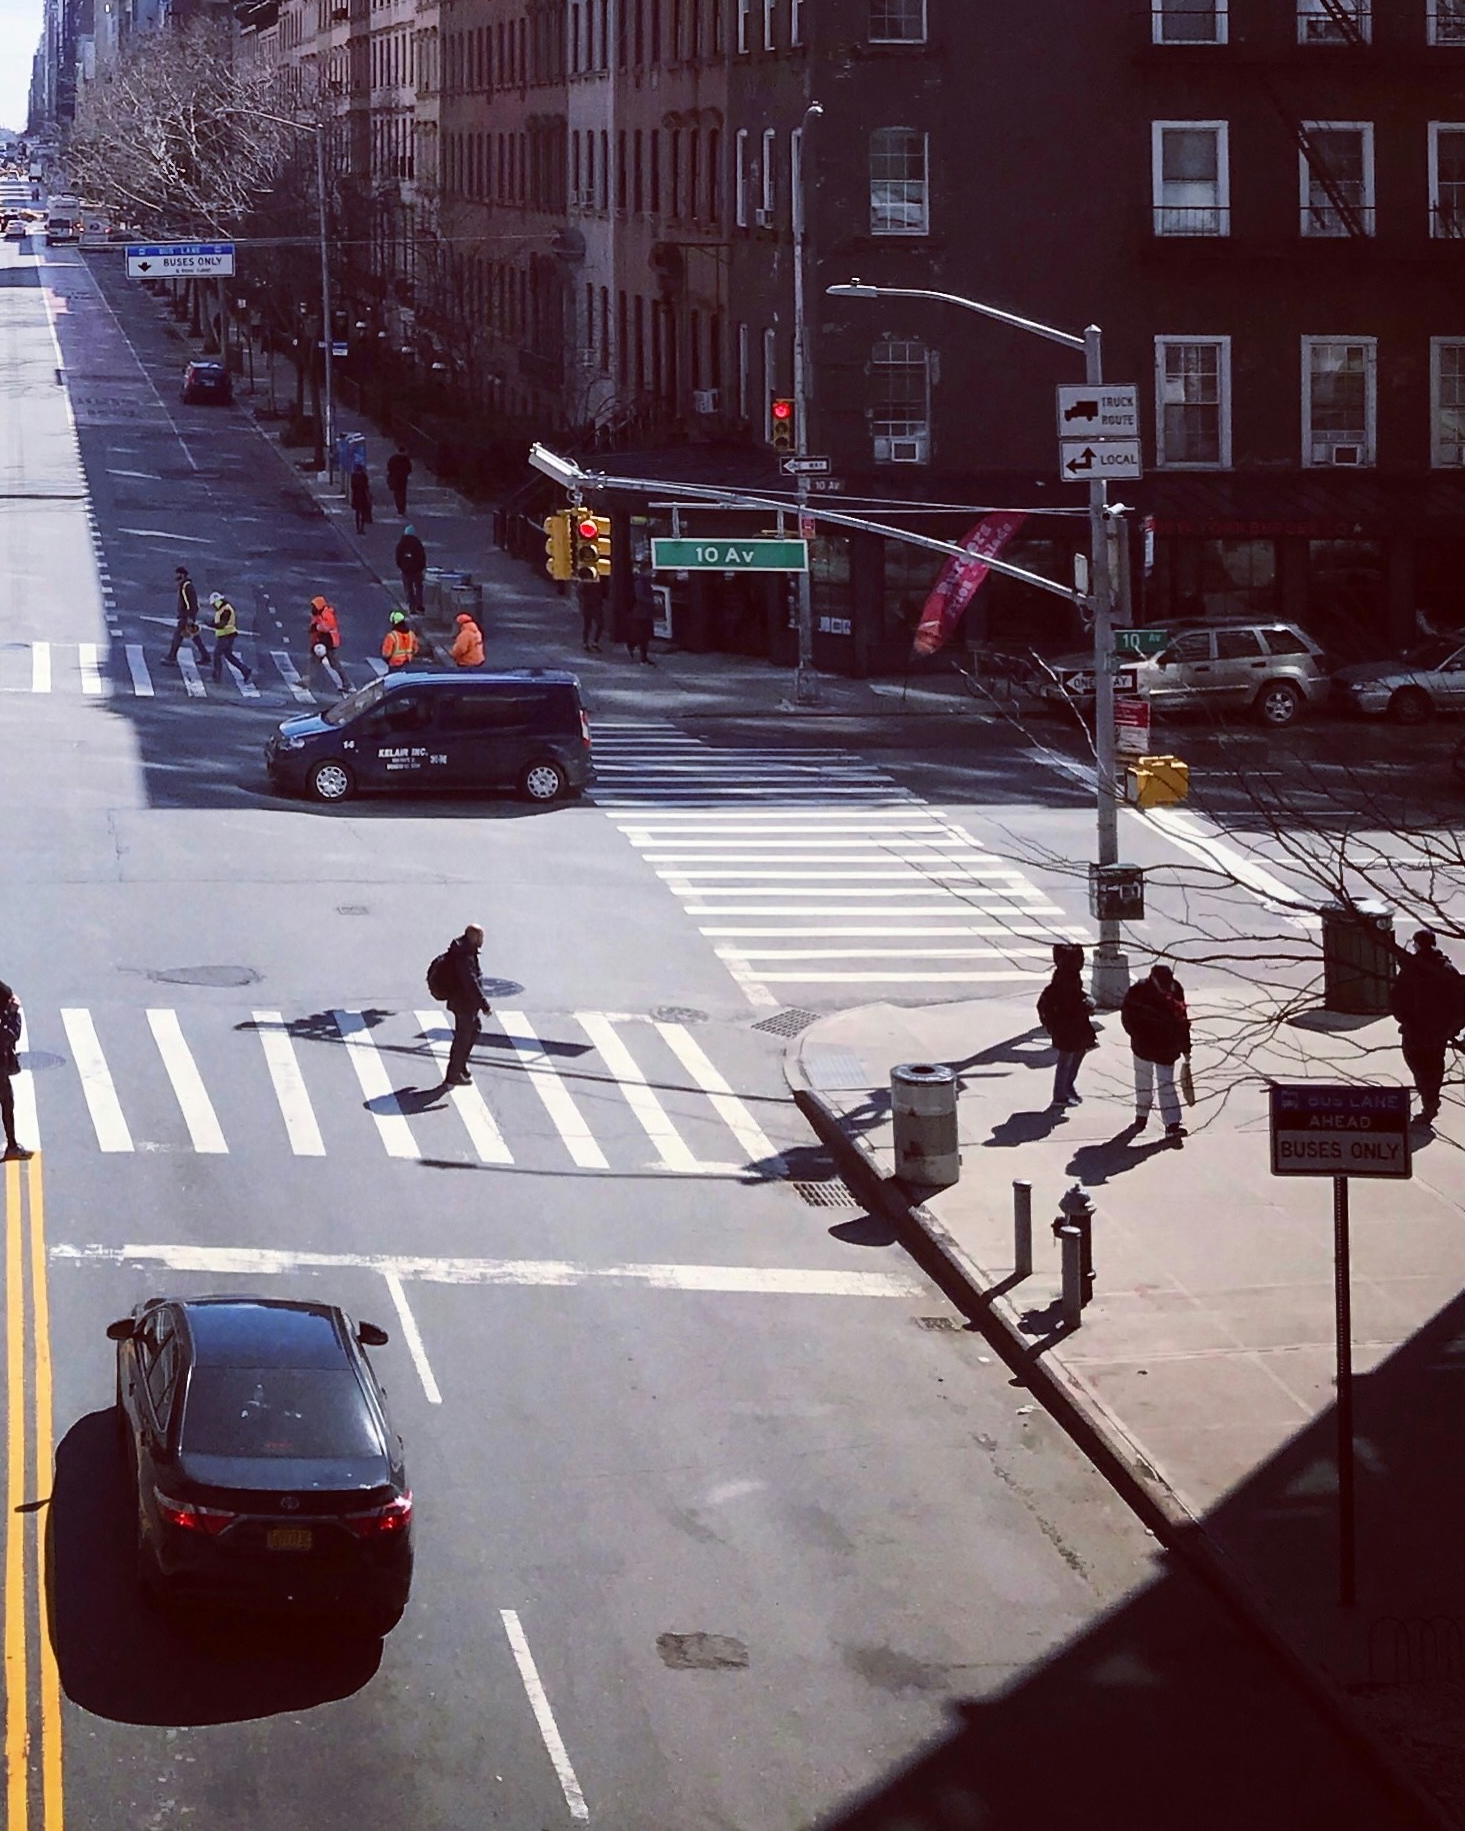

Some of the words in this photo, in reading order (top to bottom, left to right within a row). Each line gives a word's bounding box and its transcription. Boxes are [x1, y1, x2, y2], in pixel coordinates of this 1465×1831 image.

[163, 257, 194, 267] BUSES
[197, 256, 222, 266] ONLY
[1101, 396, 1134, 407] TRUCK
[1101, 414, 1134, 425] ROUTE
[1100, 454, 1138, 465] LOCAL
[815, 481, 826, 490] 10
[695, 547, 719, 563] 10
[725, 547, 754, 563] Av
[1122, 633, 1140, 648] 10
[378, 748, 409, 758] KELAIR
[1350, 1095, 1399, 1109] LANE
[1309, 1115, 1372, 1128] AHEAD
[1280, 1141, 1342, 1158] BUSES
[1350, 1142, 1400, 1160] ONLY
